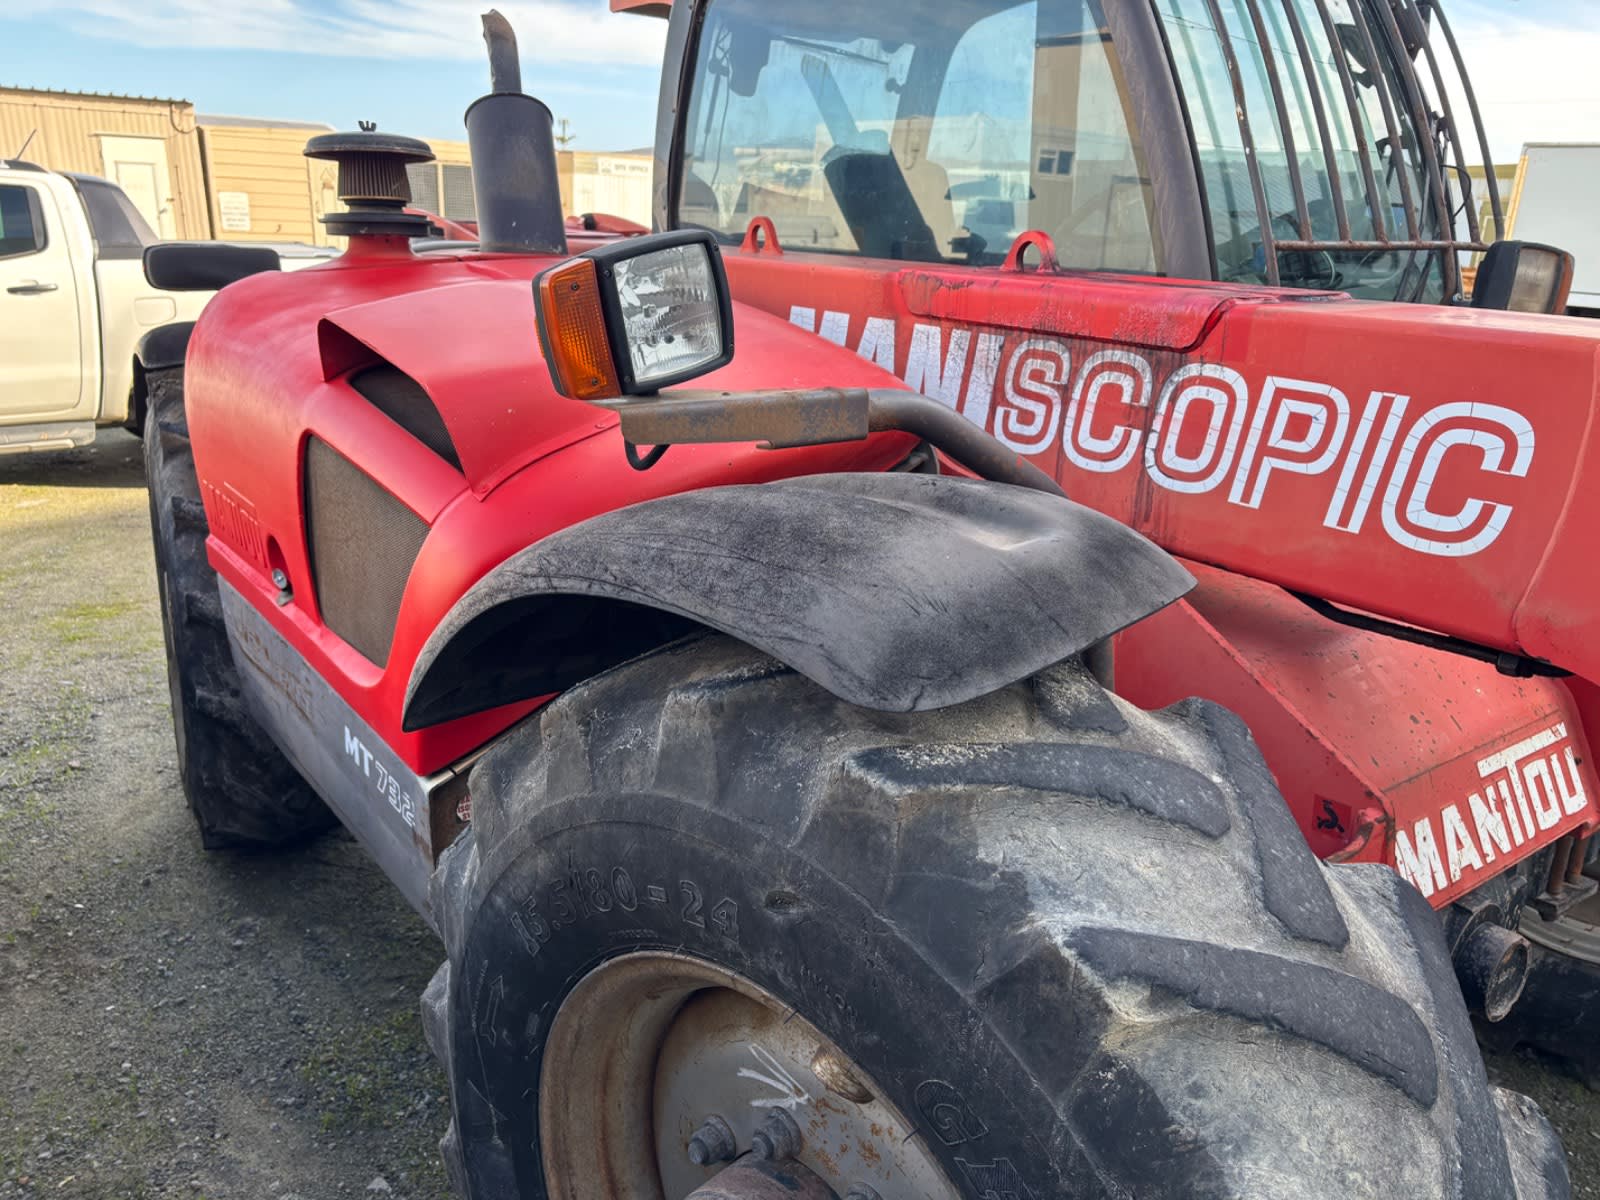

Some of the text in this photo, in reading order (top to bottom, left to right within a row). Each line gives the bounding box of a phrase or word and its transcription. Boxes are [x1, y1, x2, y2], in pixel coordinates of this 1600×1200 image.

[789, 305, 1536, 557] ANISCOPIC
[344, 725, 416, 827] MT 732
[1394, 721, 1589, 898] MANITOU
